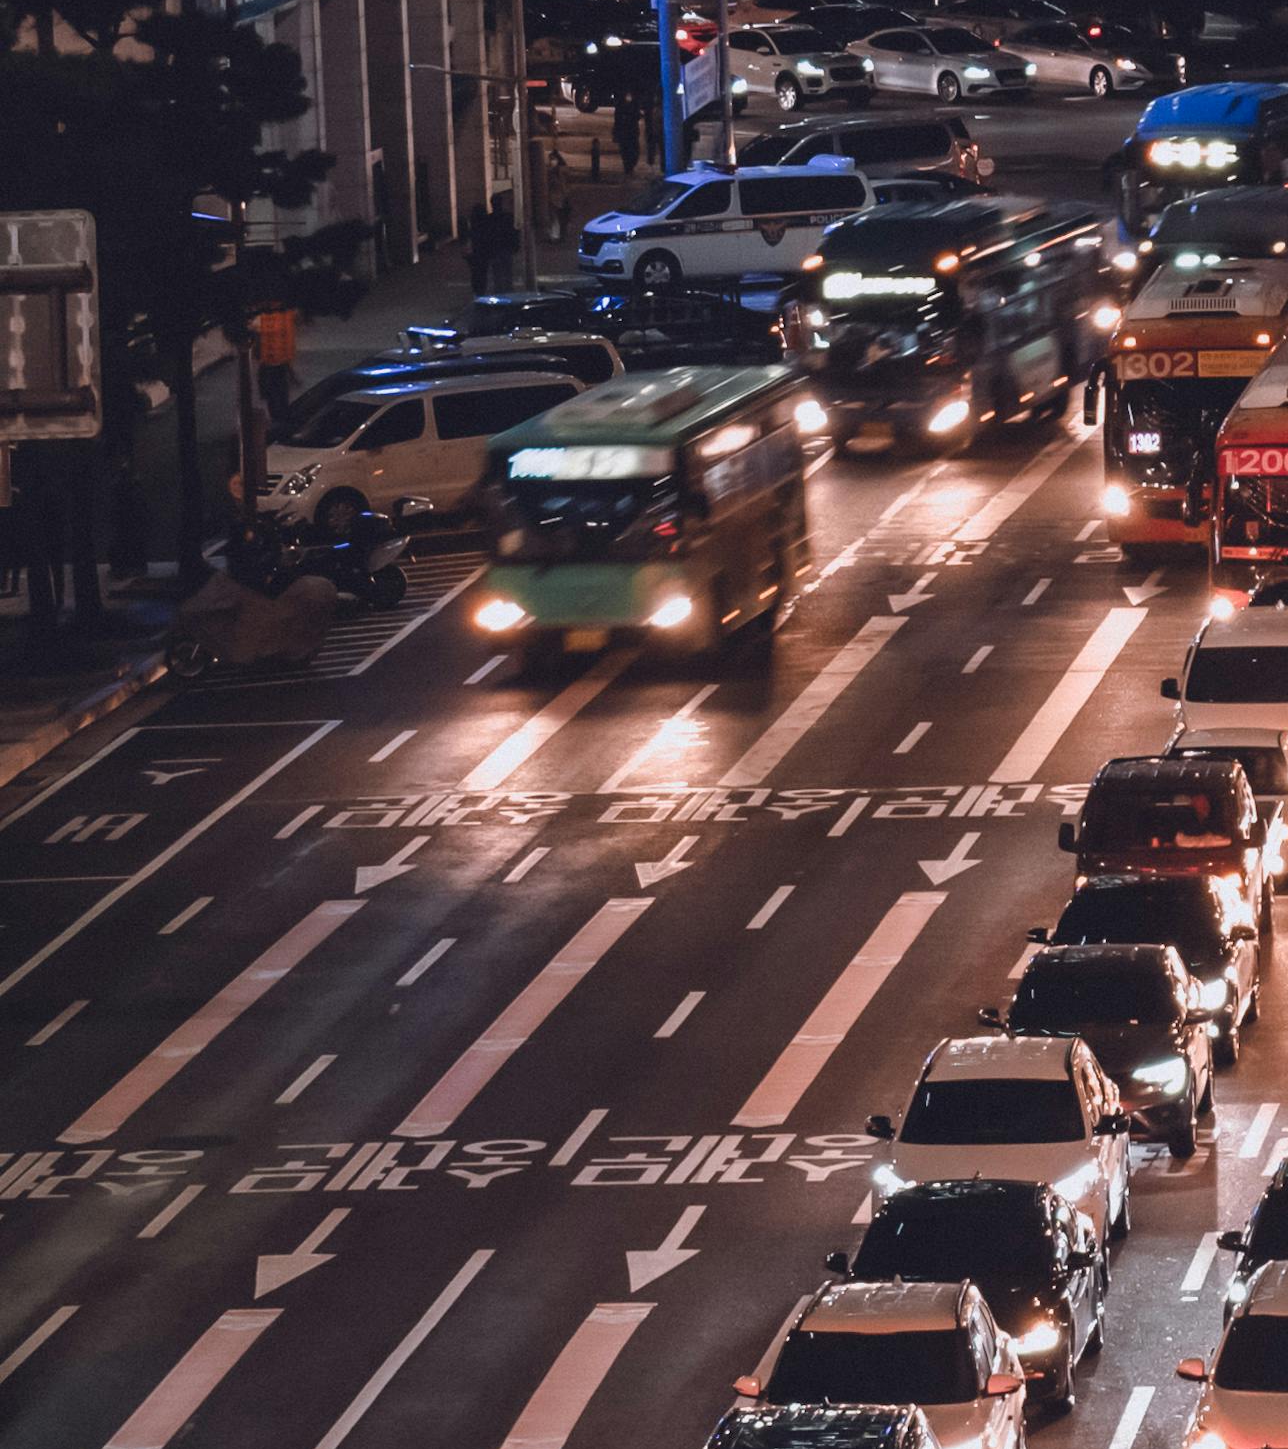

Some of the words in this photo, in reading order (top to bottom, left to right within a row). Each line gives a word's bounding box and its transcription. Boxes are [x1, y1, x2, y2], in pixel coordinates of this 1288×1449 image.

[1112, 352, 1195, 380] 1302
[1129, 433, 1161, 452] 1302
[322, 791, 578, 829] 숭례문
[599, 787, 838, 824] 숭례문
[228, 1138, 548, 1194] 숭례문
[570, 1132, 882, 1186] 숭례문
